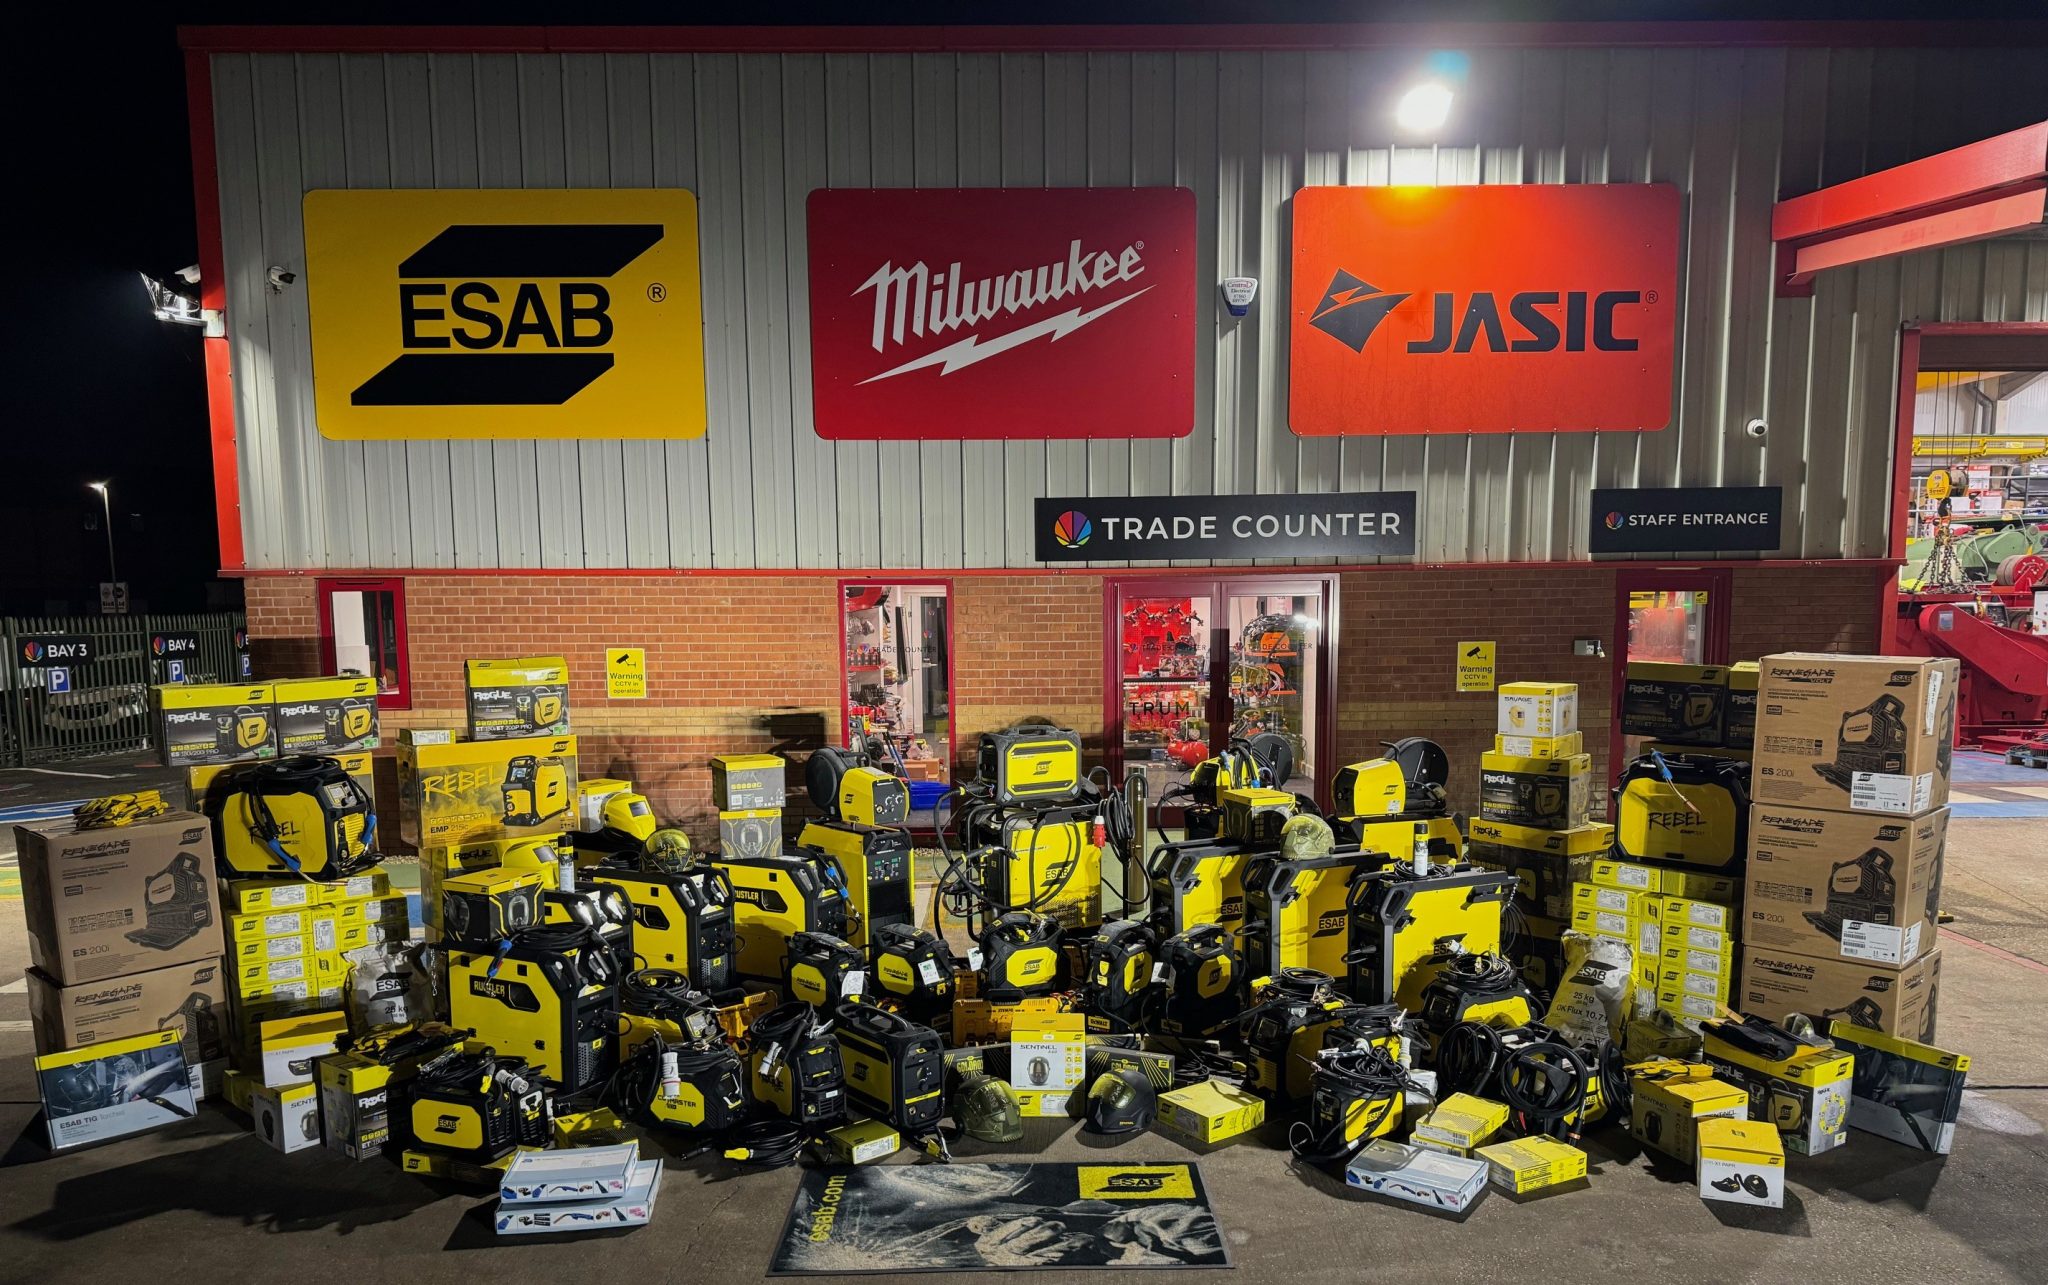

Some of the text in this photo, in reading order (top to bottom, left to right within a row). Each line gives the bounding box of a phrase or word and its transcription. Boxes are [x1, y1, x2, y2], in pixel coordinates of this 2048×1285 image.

[850, 239, 1146, 353] Milwaukee
[398, 281, 614, 350] ESAB
[1406, 290, 1641, 353] JASIC
[1101, 511, 1401, 541] TRADE COUNTER
[1628, 512, 1769, 527] STAFF ENTRANCE
[48, 642, 88, 658] BAY 3
[168, 638, 196, 651] BAY 4
[172, 663, 181, 681] P
[1459, 665, 1493, 675] Warning
[52, 671, 65, 690] P
[609, 672, 643, 682] Warning
[1890, 674, 1914, 682] ESAB
[473, 689, 513, 701] ROGUE
[1731, 695, 1757, 705] ROG
[280, 704, 321, 717] ROGUE
[168, 711, 212, 724] ROGUE
[1761, 767, 1775, 776] ES
[421, 764, 503, 803] REBEL
[1483, 773, 1516, 785] ROGUE
[1648, 811, 1708, 830] REBEL
[430, 825, 449, 834] EMP
[1318, 916, 1345, 930] ESAB
[1752, 911, 1785, 924] ES 200i
[72, 948, 88, 957] ES
[1433, 943, 1453, 956] ESA
[1576, 967, 1607, 980] ESAB
[376, 978, 410, 991] ESAB
[1572, 991, 1583, 999] 25
[1584, 991, 1595, 1004] kg
[1567, 1005, 1583, 1016] Flux
[59, 1118, 82, 1130] ESAB
[83, 1116, 98, 1126] TIG
[437, 1119, 457, 1129] ESAB
[1107, 1178, 1164, 1187] ESAB
[808, 1174, 848, 1243] esab.com
